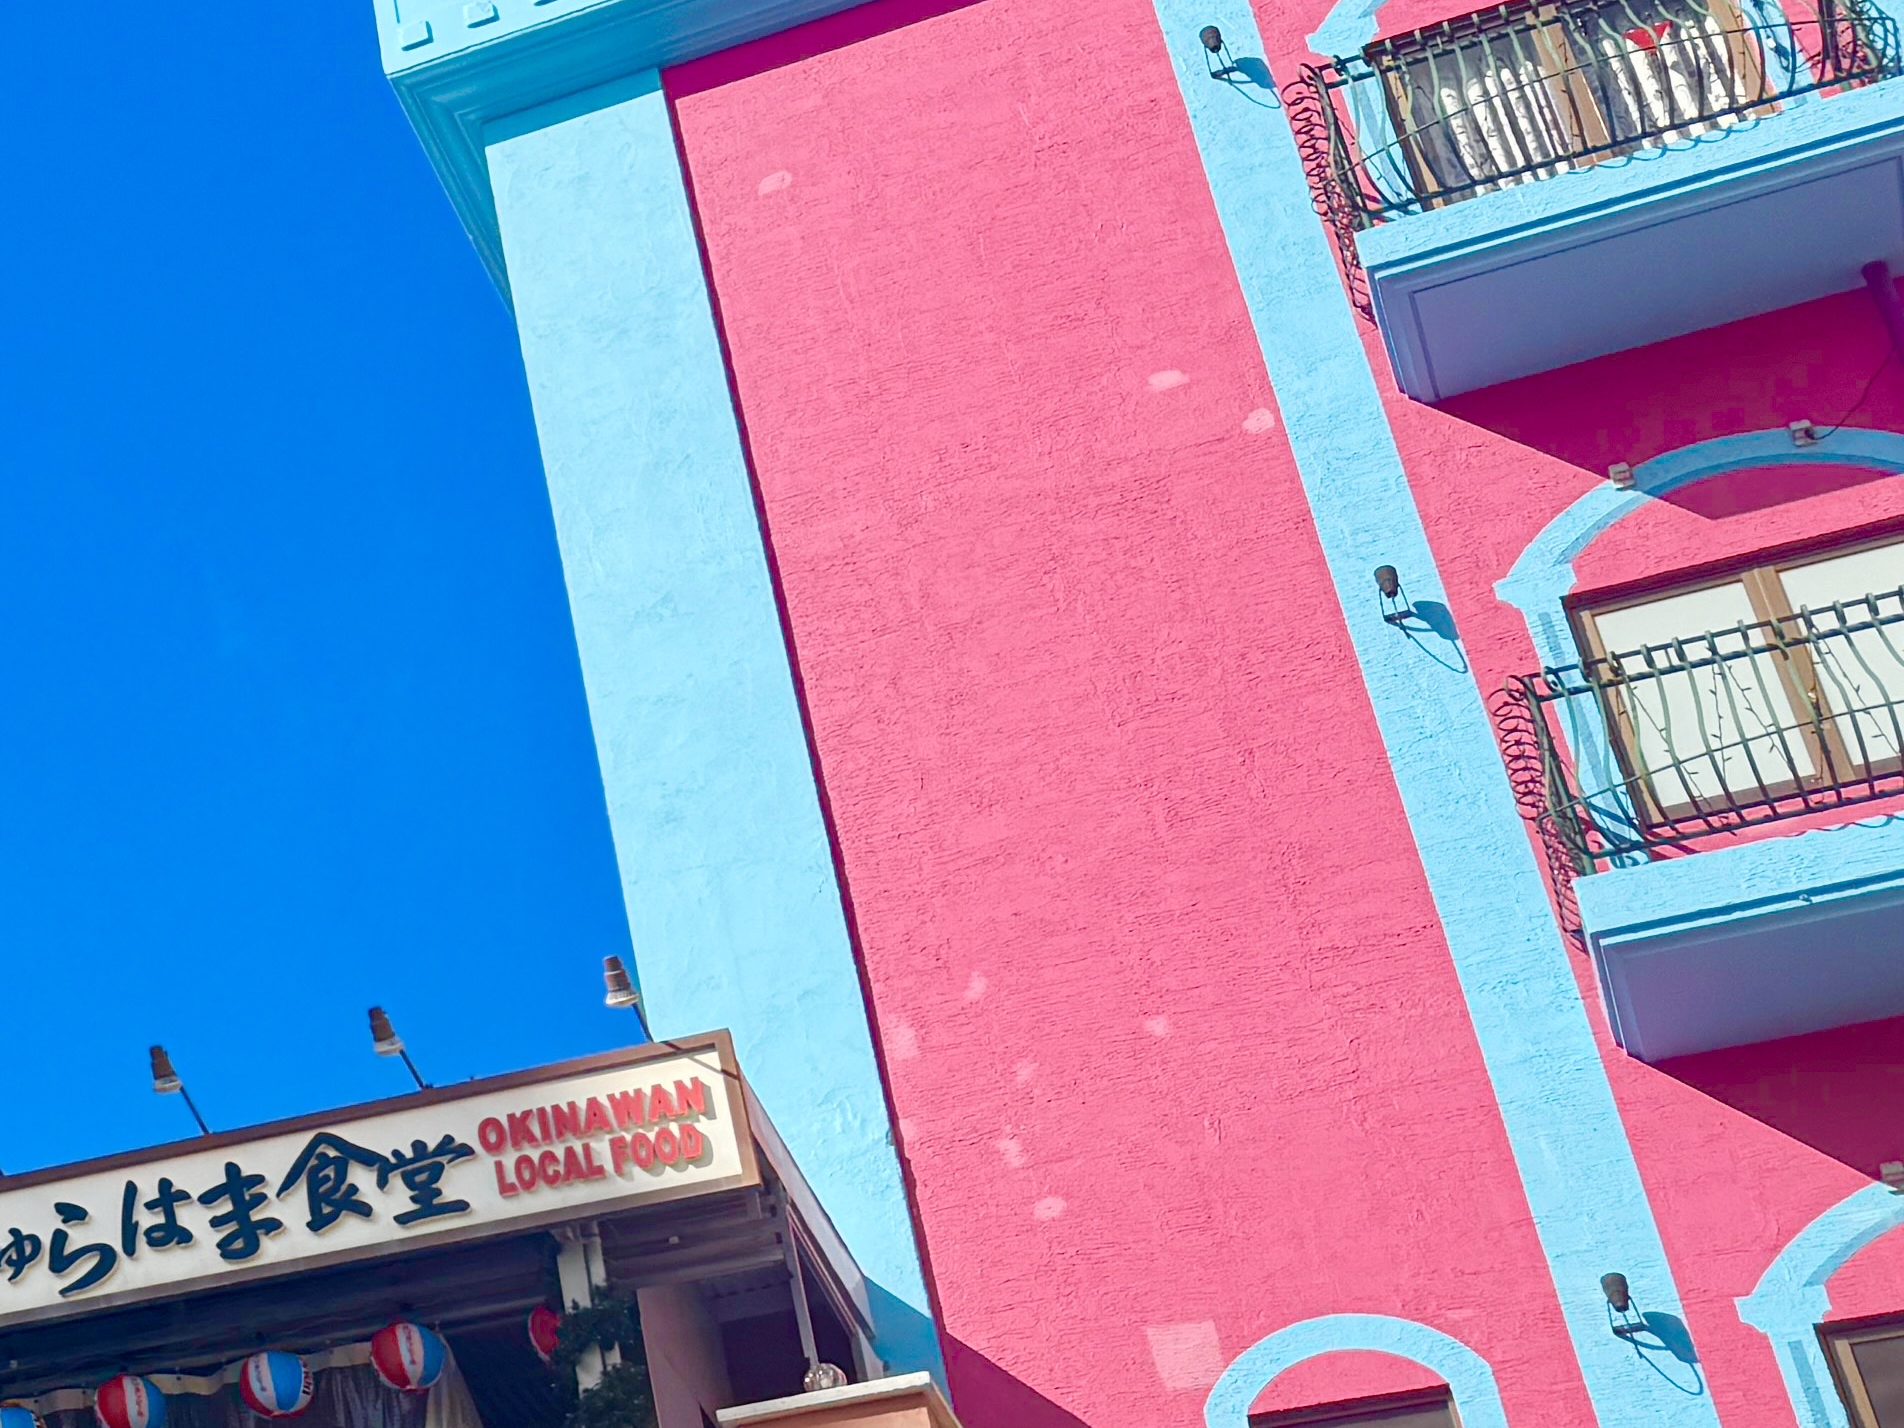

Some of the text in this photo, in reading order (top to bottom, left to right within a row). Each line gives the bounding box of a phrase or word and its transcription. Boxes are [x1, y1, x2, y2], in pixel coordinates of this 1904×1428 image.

[477, 1076, 707, 1156] OKINAWAN
[494, 1120, 705, 1196] LOCAL FOOD
